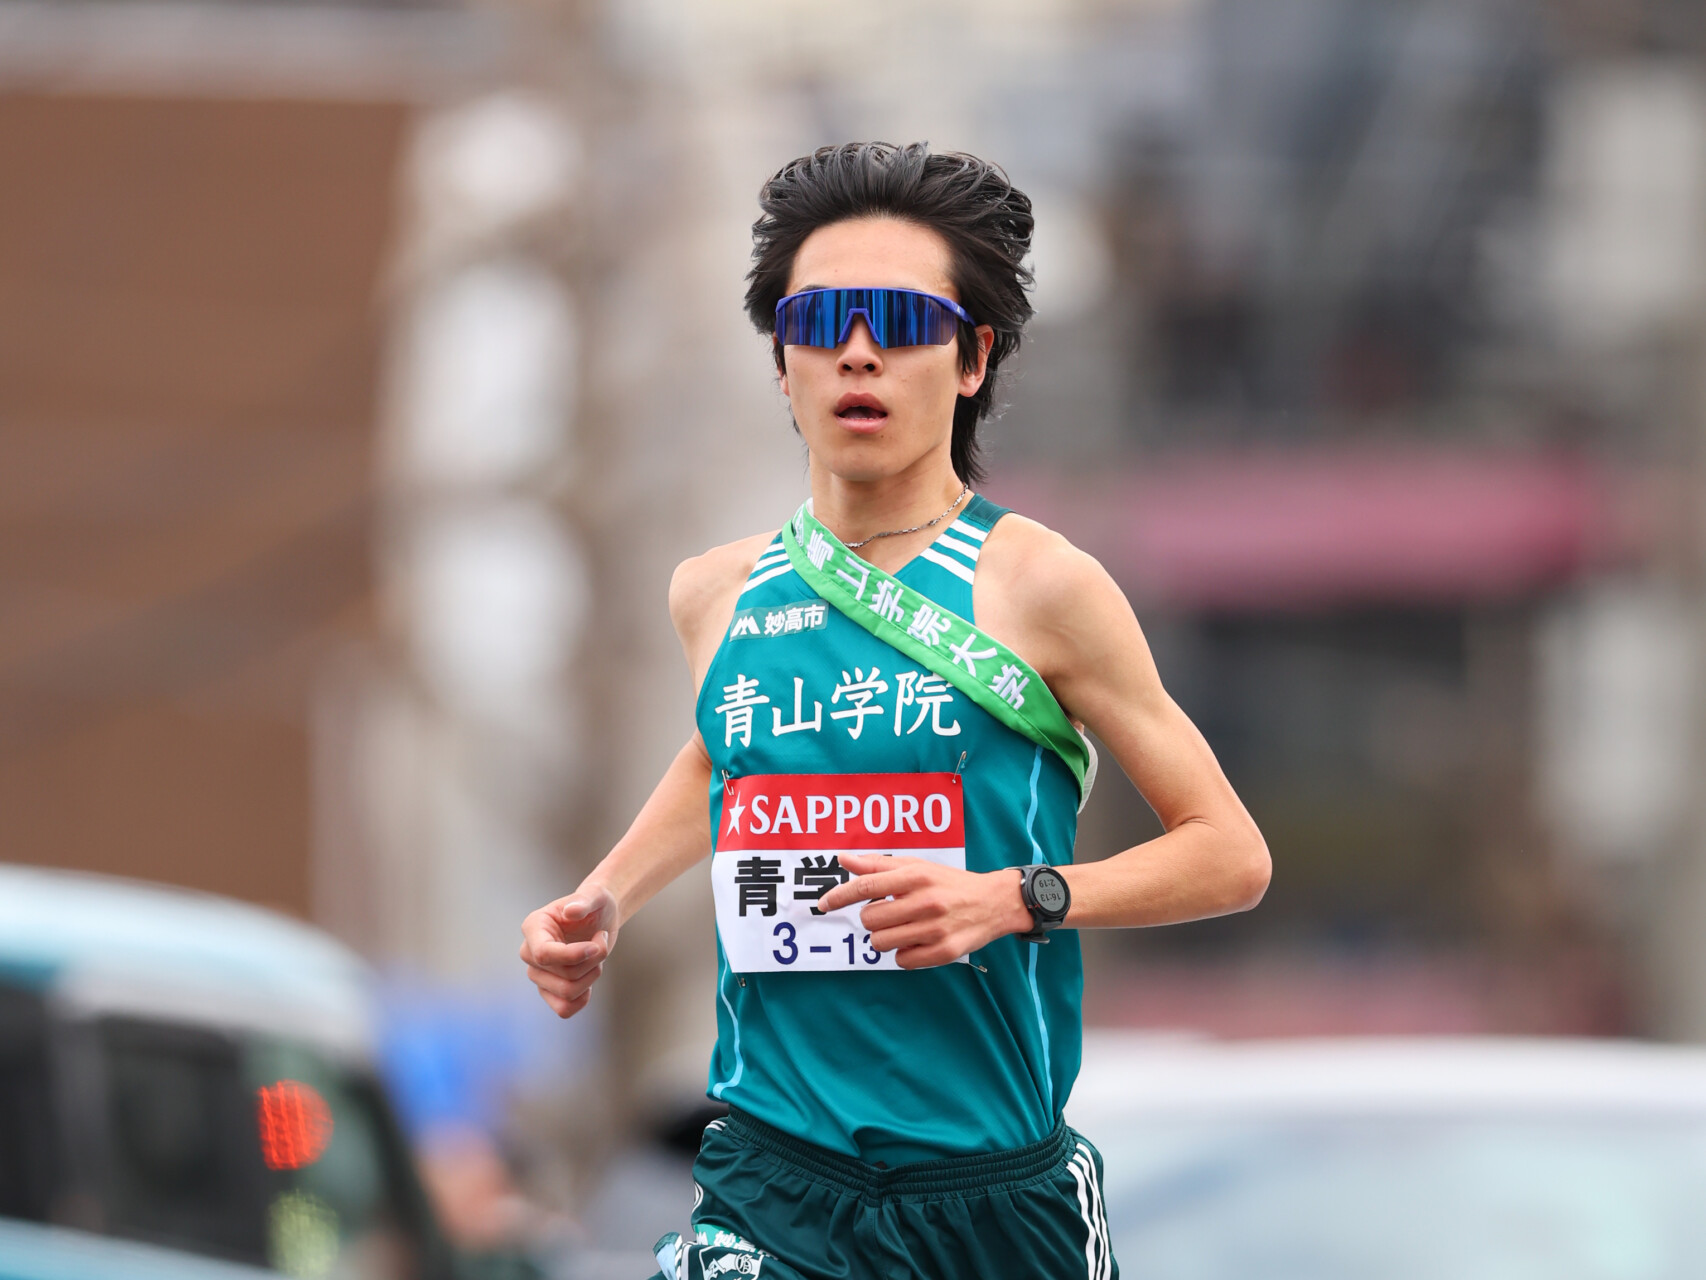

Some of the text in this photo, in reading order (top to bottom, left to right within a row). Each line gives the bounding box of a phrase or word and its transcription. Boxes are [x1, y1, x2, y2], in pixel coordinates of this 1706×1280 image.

[764, 604, 825, 635] 妙高市
[715, 667, 961, 748] 青山学院
[750, 794, 951, 834] SAPPORO
[734, 855, 893, 918] 青学
